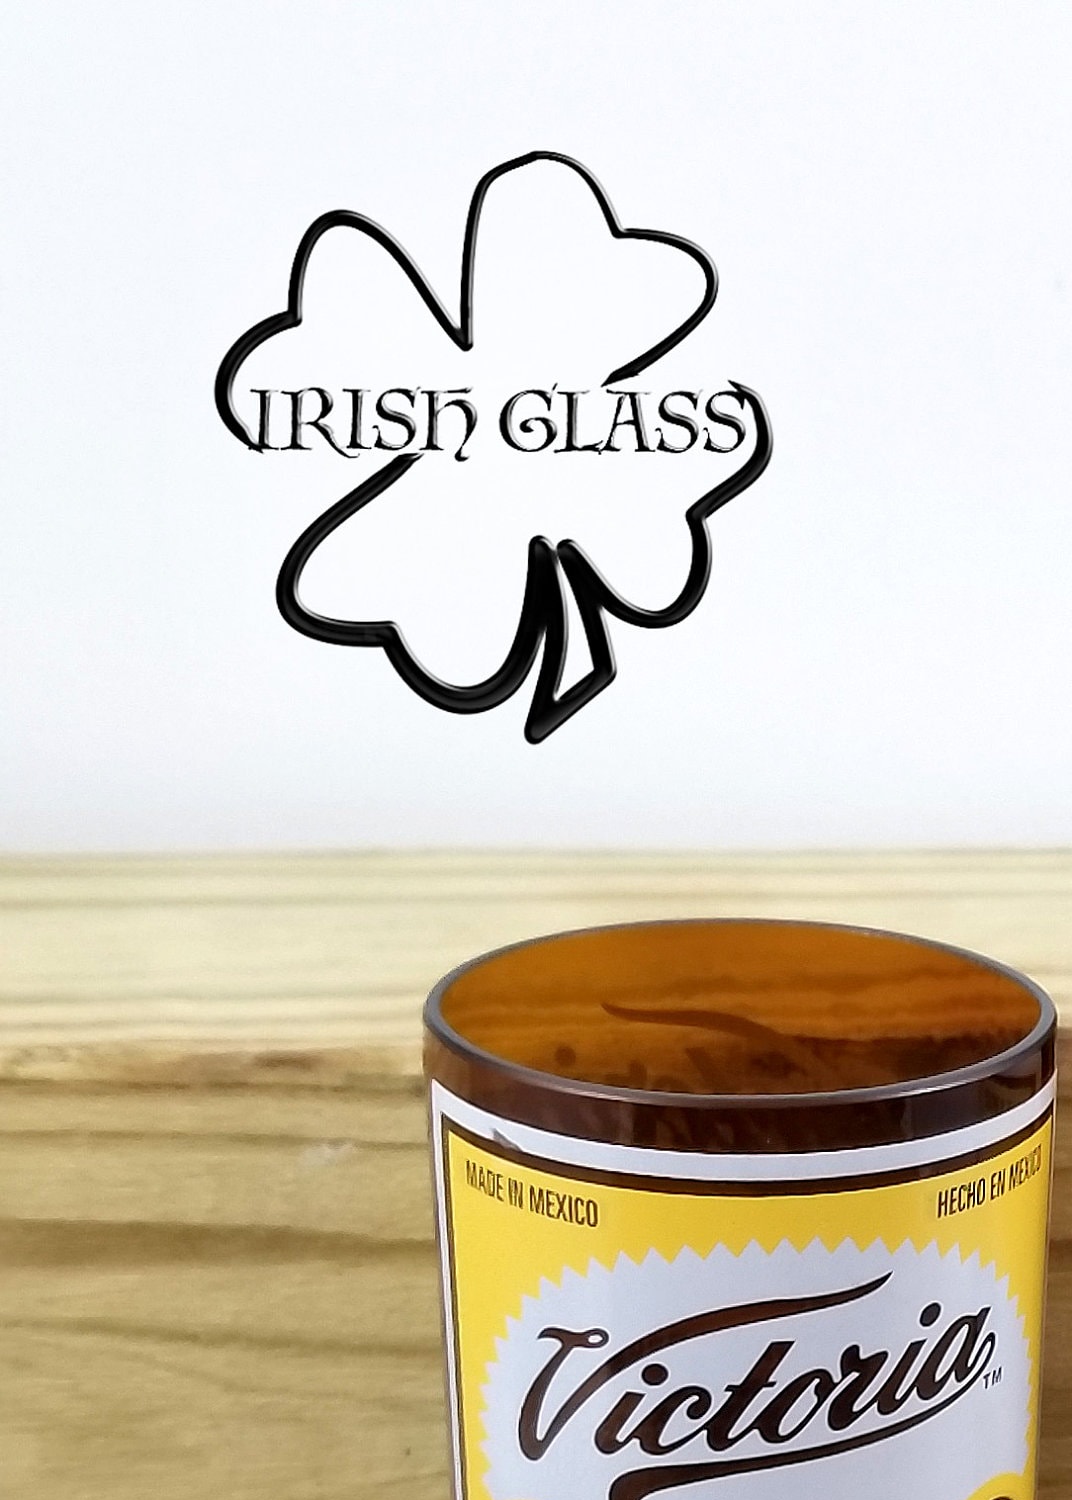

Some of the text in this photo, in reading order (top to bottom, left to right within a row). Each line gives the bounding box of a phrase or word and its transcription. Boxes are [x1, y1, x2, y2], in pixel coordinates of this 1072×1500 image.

[465, 1159, 599, 1228] MADE IN MEXICO
[937, 1177, 987, 1219] HECHO
[990, 1167, 1007, 1201] EN
